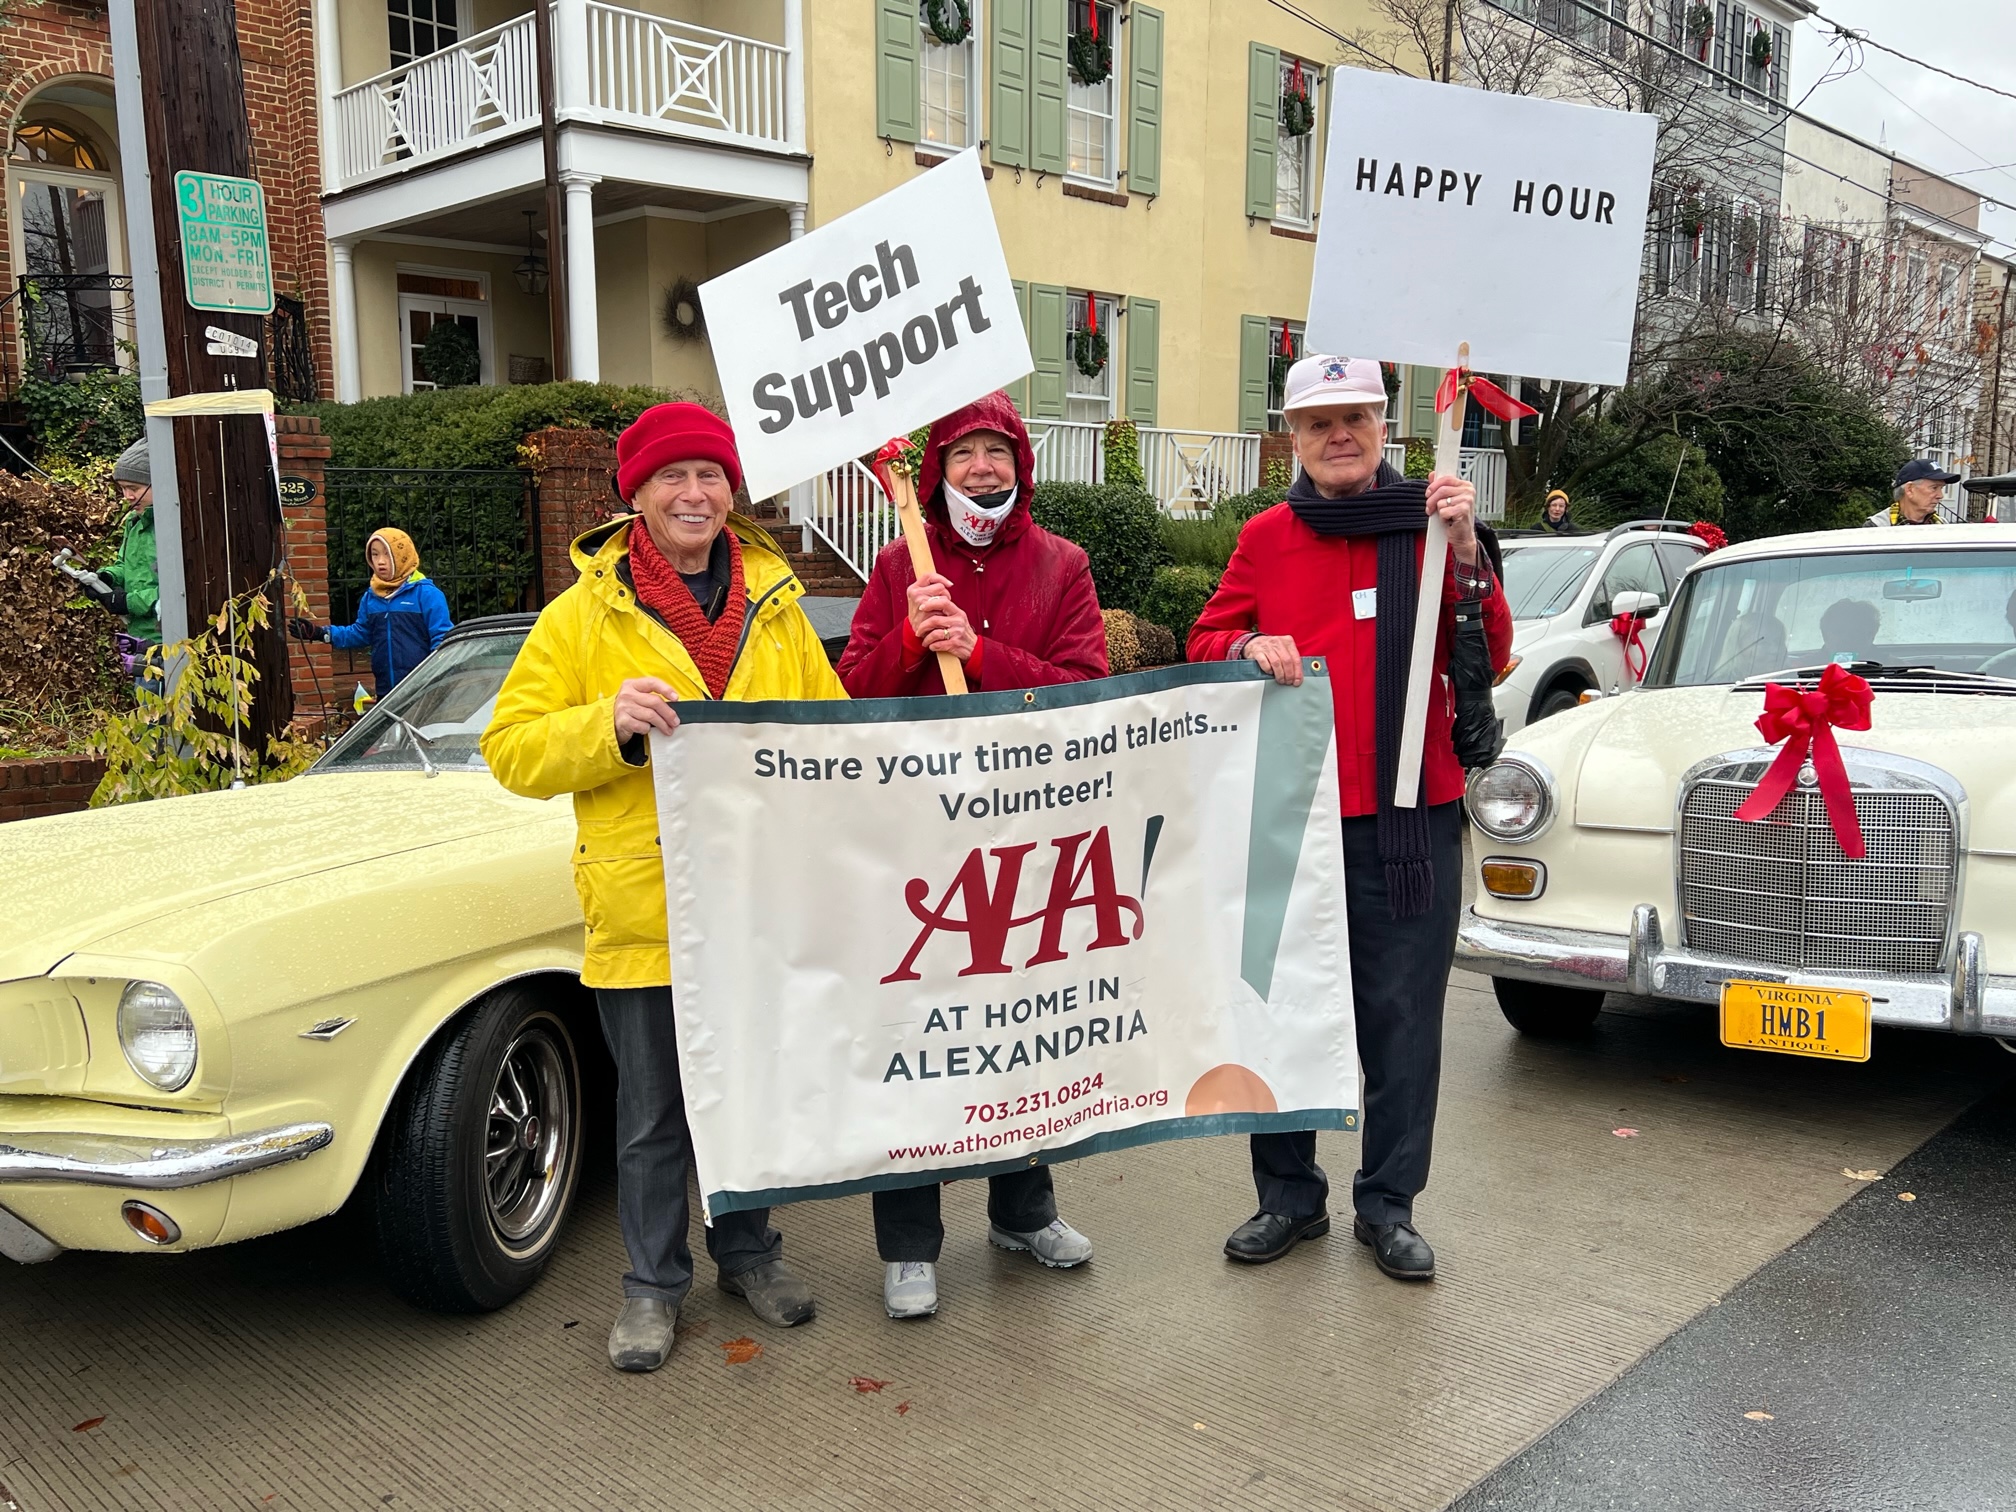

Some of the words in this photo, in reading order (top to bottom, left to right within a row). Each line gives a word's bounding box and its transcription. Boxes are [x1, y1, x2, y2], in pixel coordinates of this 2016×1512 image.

[181, 177, 203, 218] 3
[210, 183, 253, 204] HOUR
[1356, 157, 1482, 205] HAPPY
[1513, 180, 1615, 225] HOUR
[208, 203, 259, 225] PARKING
[192, 265, 218, 275] EXCEPT
[222, 268, 252, 279] HOLDERS
[256, 271, 264, 279] OF
[193, 277, 224, 288] DISTRICT
[236, 281, 266, 291] PERMITS
[778, 239, 920, 342] Tech
[752, 275, 992, 434] Support
[280, 482, 305, 494] 525
[754, 748, 863, 781] Share
[876, 751, 961, 784] your
[975, 741, 1053, 772] time
[1064, 725, 1117, 761] and
[1126, 711, 1238, 750] talents...
[939, 771, 1113, 821] Volunteer!
[923, 1005, 969, 1033] AT
[985, 985, 1078, 1028] HOME
[1089, 976, 1120, 1003] IN
[1757, 989, 1832, 1006] VIRGINIA
[1761, 1004, 1826, 1040] HMB1
[882, 1009, 1148, 1083] ALEXANDRIA
[1757, 1038, 1831, 1053] ANTIQUE
[963, 1072, 1104, 1124] 703.231.0824
[888, 1089, 1169, 1160] www.athomealexandria.org
